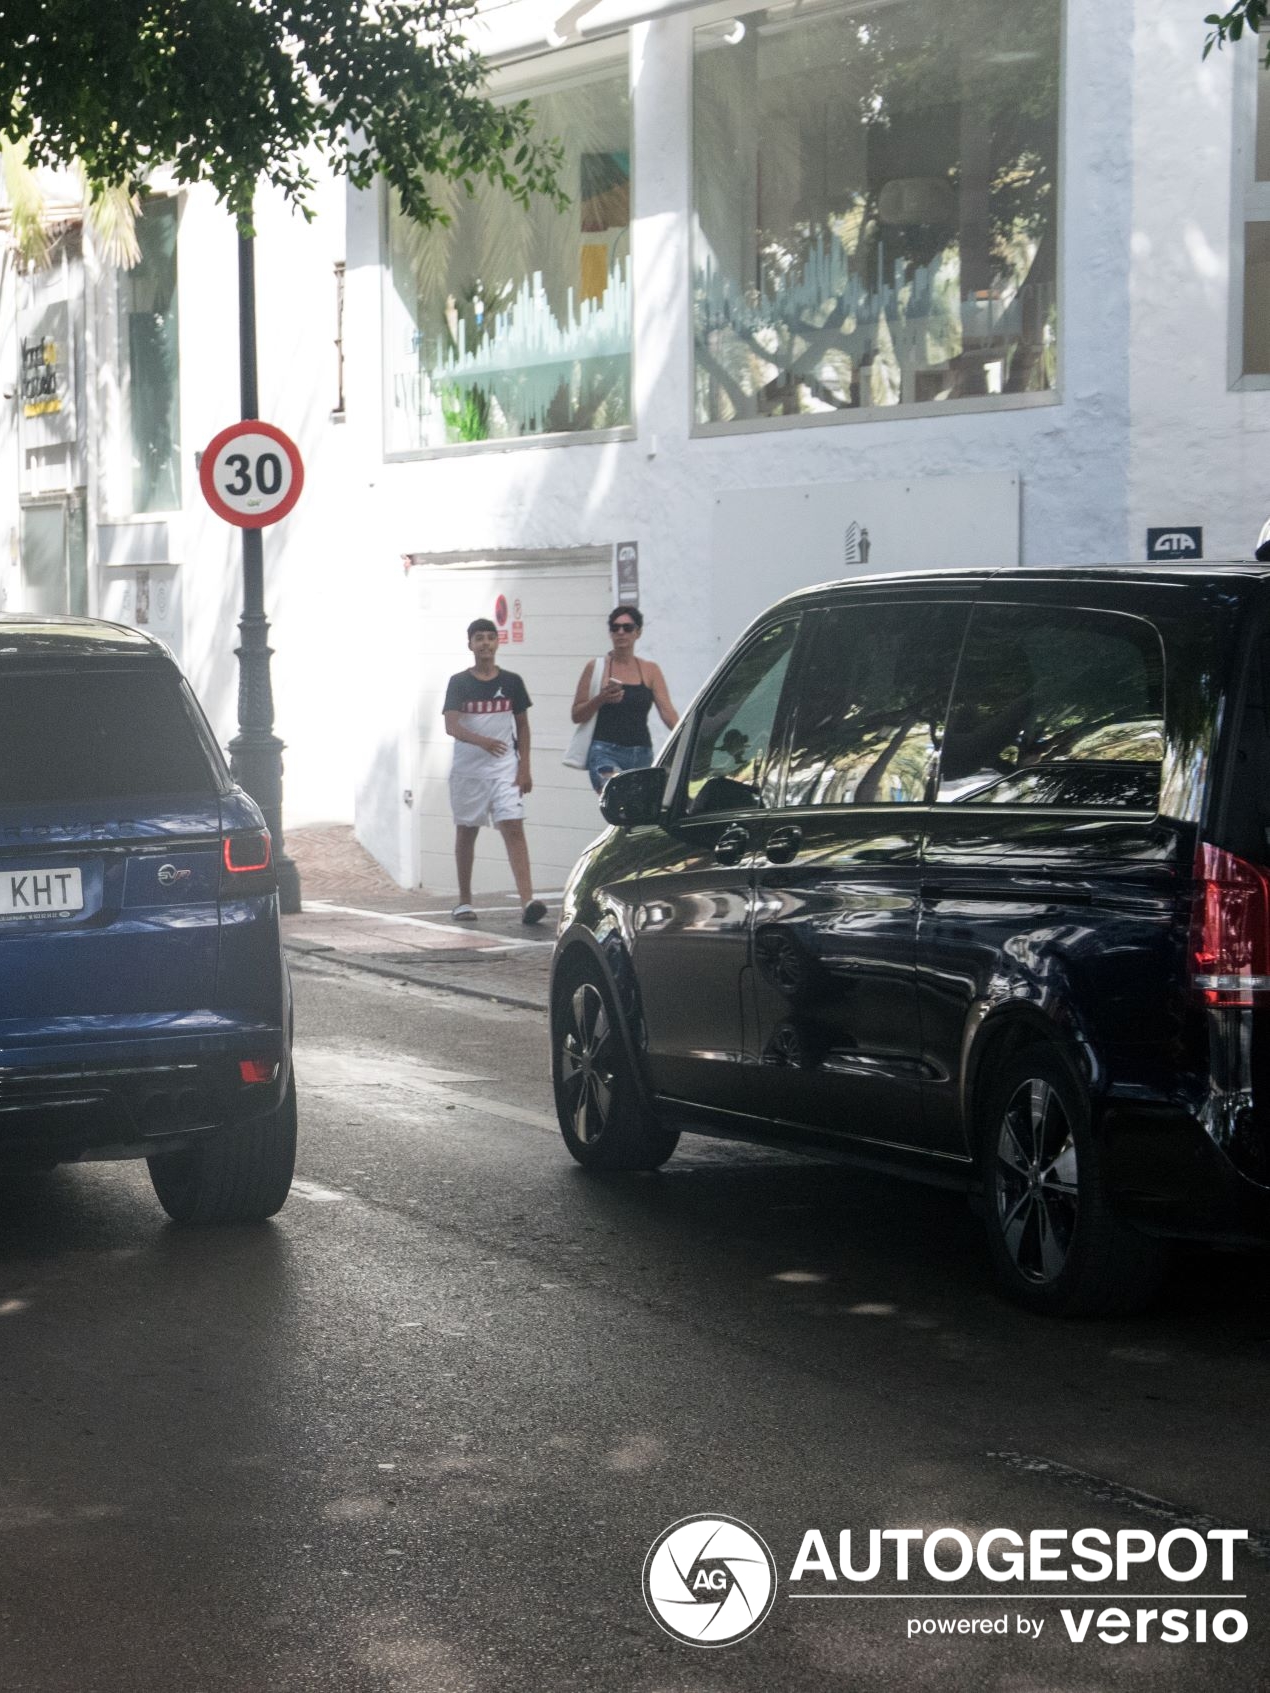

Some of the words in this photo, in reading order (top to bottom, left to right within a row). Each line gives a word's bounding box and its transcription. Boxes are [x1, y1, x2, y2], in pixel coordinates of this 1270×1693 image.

[225, 453, 282, 496] 30
[1154, 533, 1196, 551] GTA
[11, 873, 72, 907] KHT
